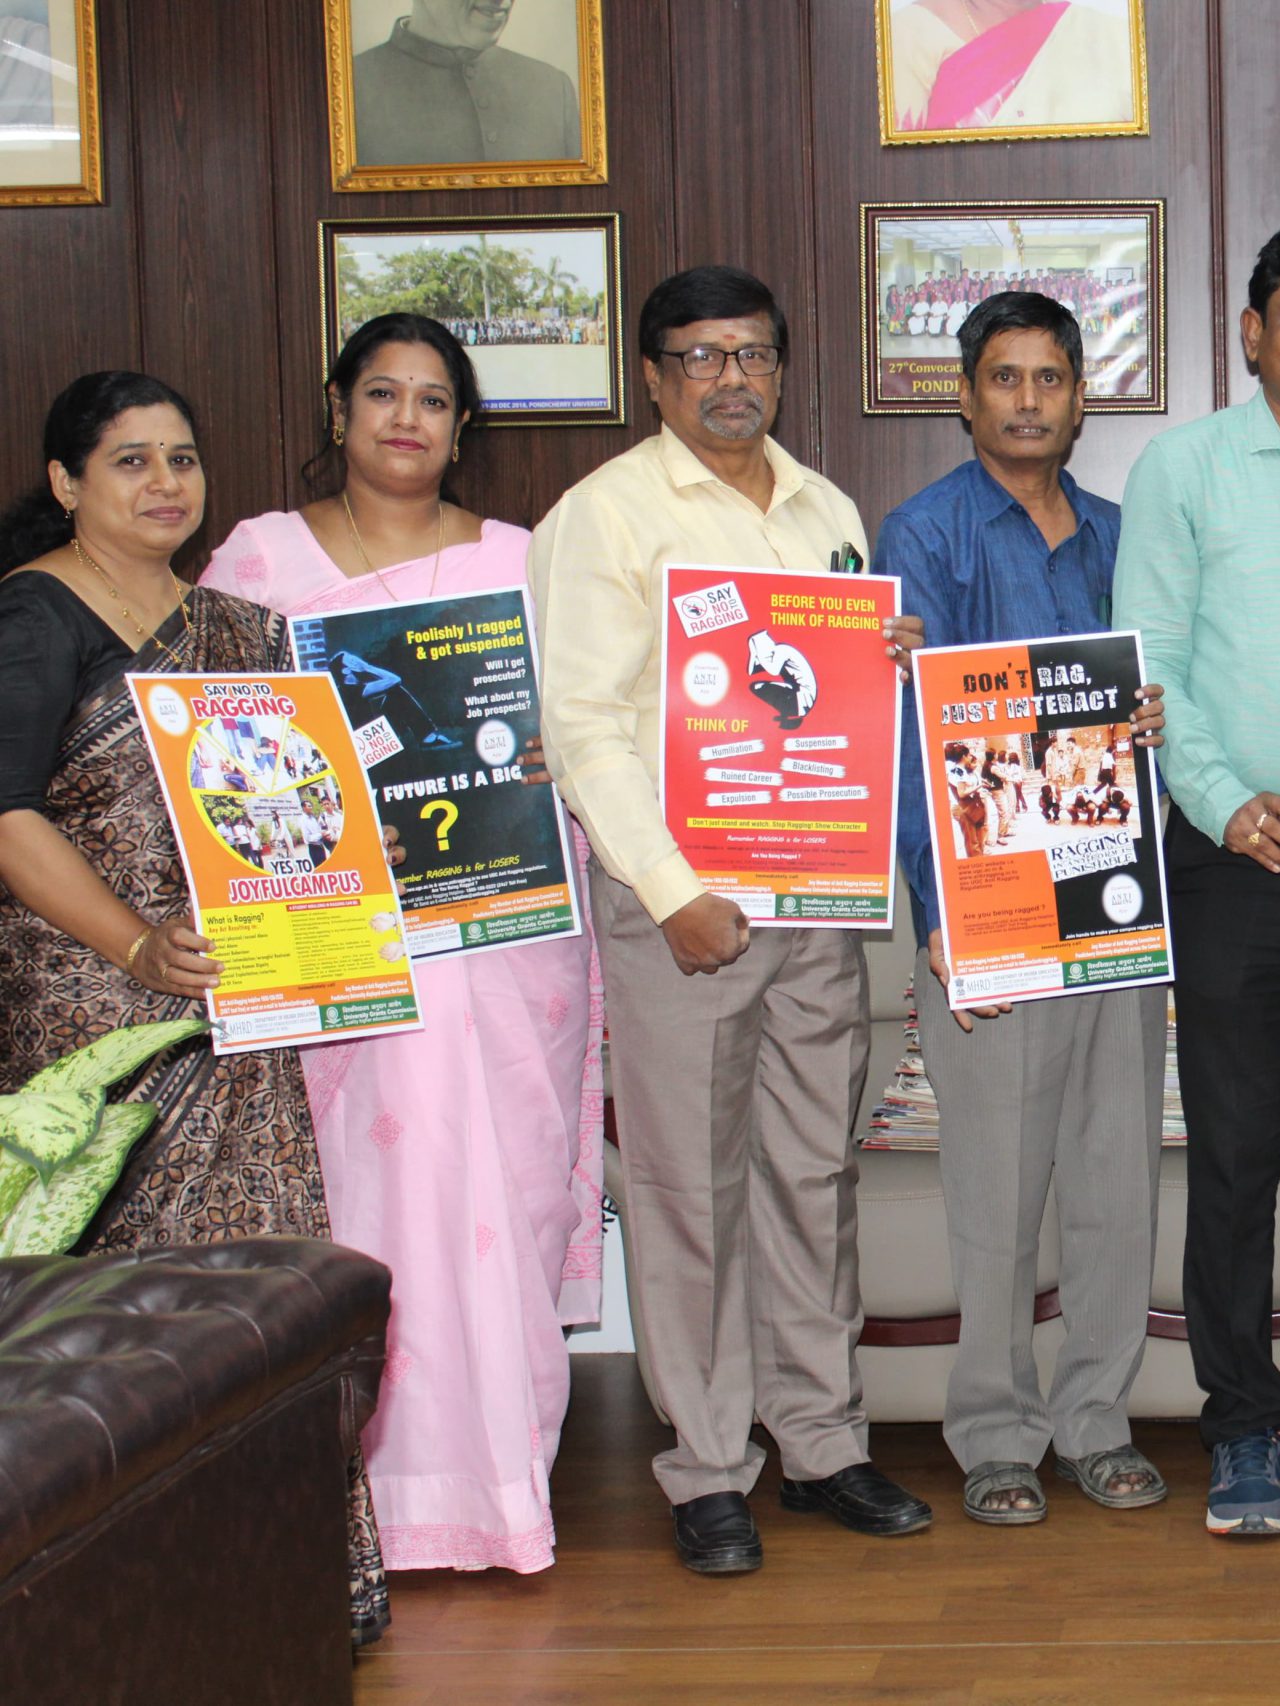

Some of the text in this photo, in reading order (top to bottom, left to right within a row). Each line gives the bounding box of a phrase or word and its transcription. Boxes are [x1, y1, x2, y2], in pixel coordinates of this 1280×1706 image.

[707, 587, 732, 604] SAY
[771, 594, 875, 612] BEFORE YOU EVEN
[712, 602, 729, 614] NO
[691, 608, 744, 633] RAGGING
[771, 612, 879, 630] THINK OF RAGGING
[407, 616, 522, 644] Foolishly I ragged
[416, 633, 524, 661] & got suspended
[485, 657, 525, 670] Will I get
[474, 669, 526, 686] prosecuted?
[963, 662, 1092, 694] DON'T RAG,
[204, 685, 270, 696] SAY NO TO
[464, 691, 530, 707] What about my
[191, 698, 294, 717] RAGGING
[466, 701, 532, 719] Job prospects?
[941, 686, 1118, 726] JUST INTERACT
[362, 722, 386, 741] SAY
[685, 718, 748, 733] THINK OF
[369, 736, 385, 750] NO
[712, 743, 753, 757] Humiliation
[795, 738, 836, 748] Suspension
[721, 771, 772, 783] Ruined Career
[792, 762, 834, 775] Blacklisting
[383, 765, 522, 802] FUTURE IS A BIG
[721, 793, 756, 804] Expulsion
[787, 789, 861, 799] Possible Prosecution
[420, 800, 458, 851] ?
[1051, 832, 1130, 860] RAGGING
[271, 859, 312, 875] YES TO
[1055, 855, 1133, 879] PUNISHABLE
[231, 872, 361, 901] JOYFULCAMPUS
[1087, 961, 1168, 976] University Grants Commission
